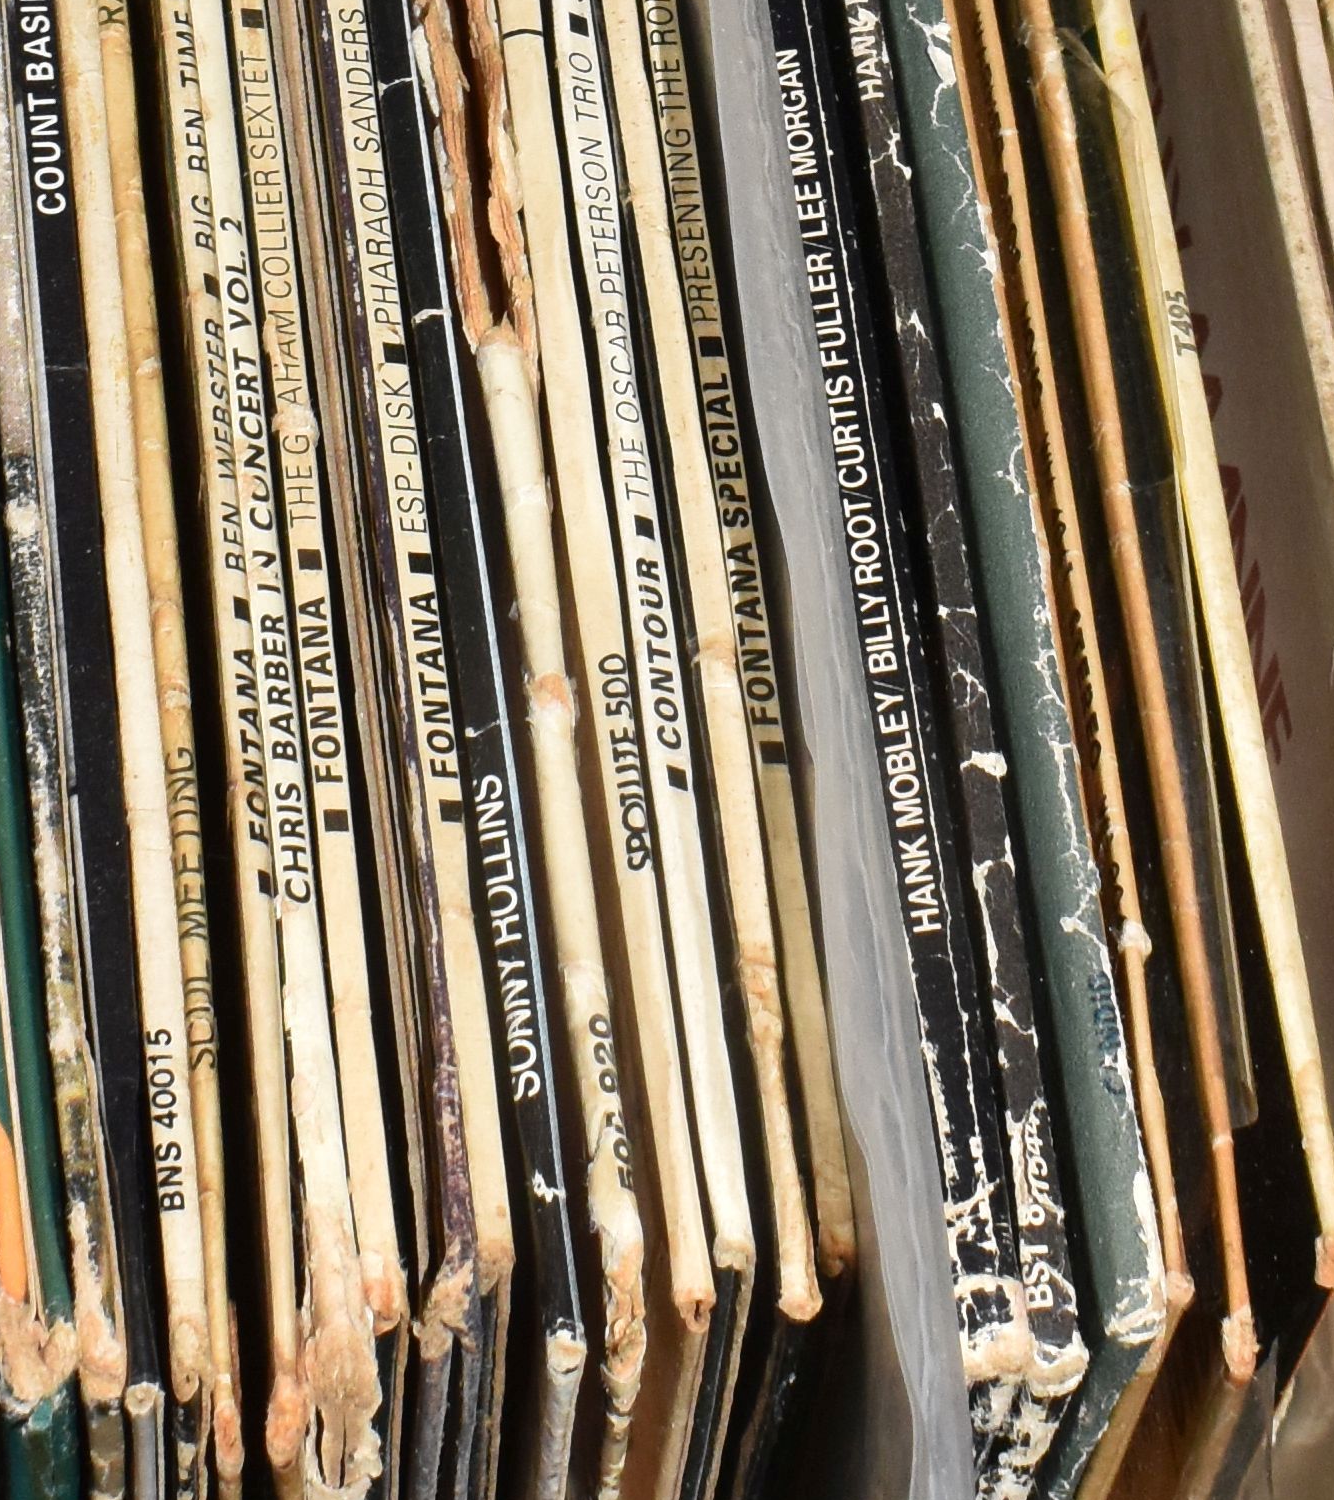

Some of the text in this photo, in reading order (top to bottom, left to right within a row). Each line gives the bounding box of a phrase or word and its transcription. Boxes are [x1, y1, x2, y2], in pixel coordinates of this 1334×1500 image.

[26, 90, 67, 215] COUNT
[239, 50, 279, 161] SEXTET
[340, 6, 385, 153] SANDERS
[566, 49, 601, 123] TRIO
[654, 55, 691, 118] THE
[251, 166, 293, 297] COLLIER
[359, 166, 406, 325] PHARAOH
[578, 136, 624, 294] PETERSON
[664, 125, 721, 324] PRESENTING
[384, 377, 432, 534] ESP-DISK
[618, 435, 651, 502] THE
[700, 371, 751, 528] SPECIAL
[773, 47, 945, 934] HANK BILLY MORGAN
[232, 350, 315, 905] CHRIS BARBER CONCERT
[296, 594, 345, 784] FONTANA
[409, 589, 462, 779] FONTANA
[597, 651, 634, 718] 500
[634, 556, 685, 752] CONTOUR
[724, 540, 781, 727] FONTANA
[165, 745, 210, 941] MEETING
[145, 1026, 188, 1213] BNS 40015
[1019, 1230, 1057, 1307] BST
